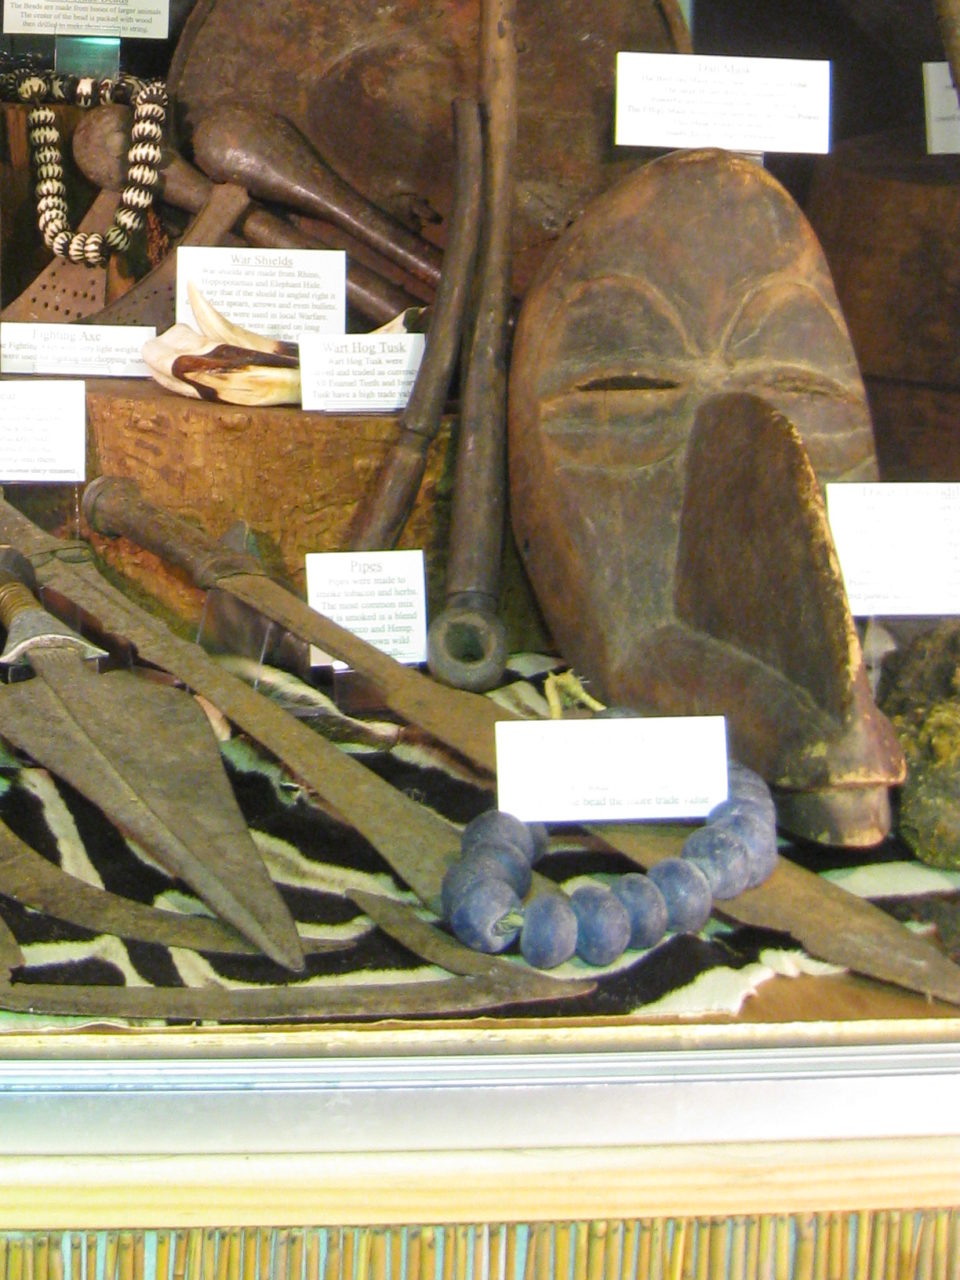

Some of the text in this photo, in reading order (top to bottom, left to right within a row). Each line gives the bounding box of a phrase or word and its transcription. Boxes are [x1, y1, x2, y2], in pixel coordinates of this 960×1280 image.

[231, 255, 293, 268] War Shields
[352, 342, 376, 355] Hog
[379, 342, 407, 353] Tusk
[351, 560, 383, 574] Pipes
